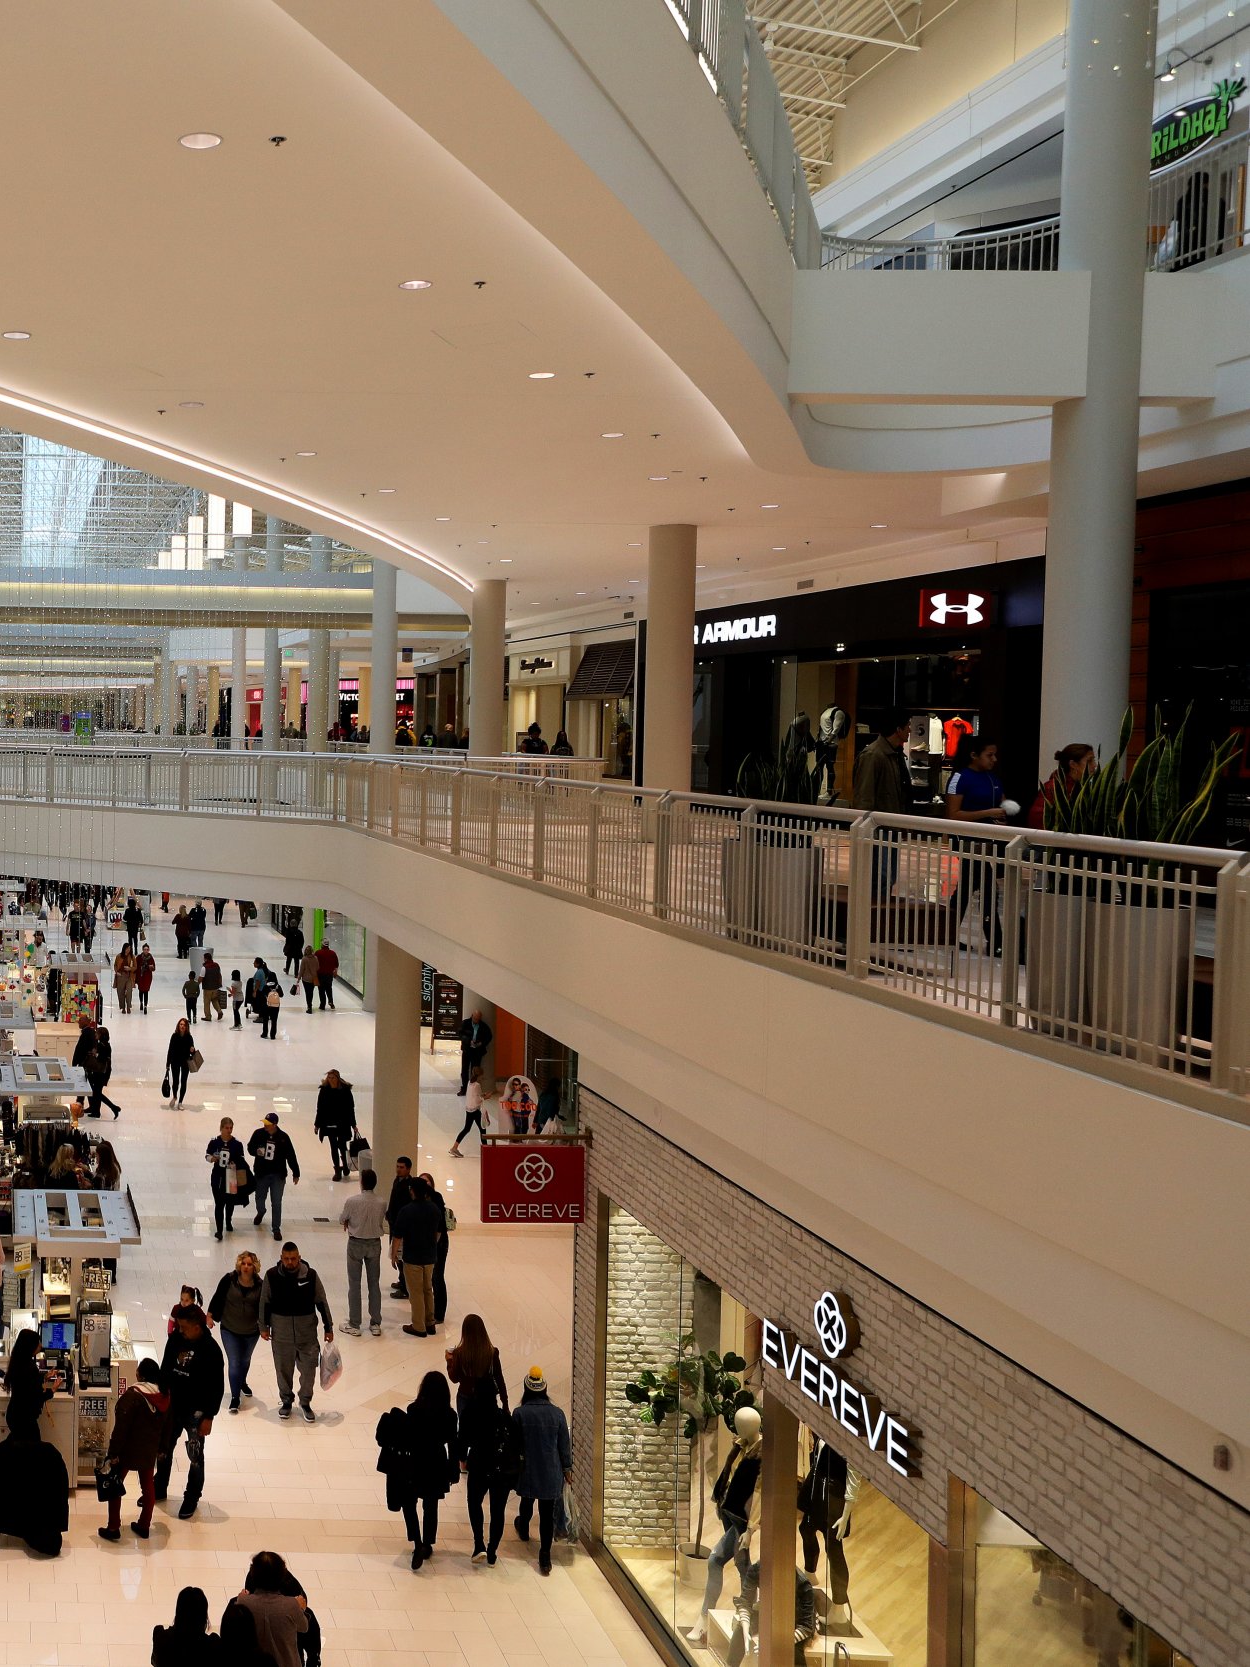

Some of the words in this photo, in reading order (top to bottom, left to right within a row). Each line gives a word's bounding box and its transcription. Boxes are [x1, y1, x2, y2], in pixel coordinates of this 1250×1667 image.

[701, 614, 777, 645] ARMOUR
[421, 963, 434, 1002] slightly
[500, 1101, 517, 1111] TOO
[519, 1102, 538, 1112] COO
[219, 1150, 230, 1168] 8
[488, 1203, 581, 1218] EVEREVE
[84, 1273, 111, 1284] FREE!
[79, 1400, 107, 1410] FREE!
[762, 1317, 909, 1478] EVEREVE
